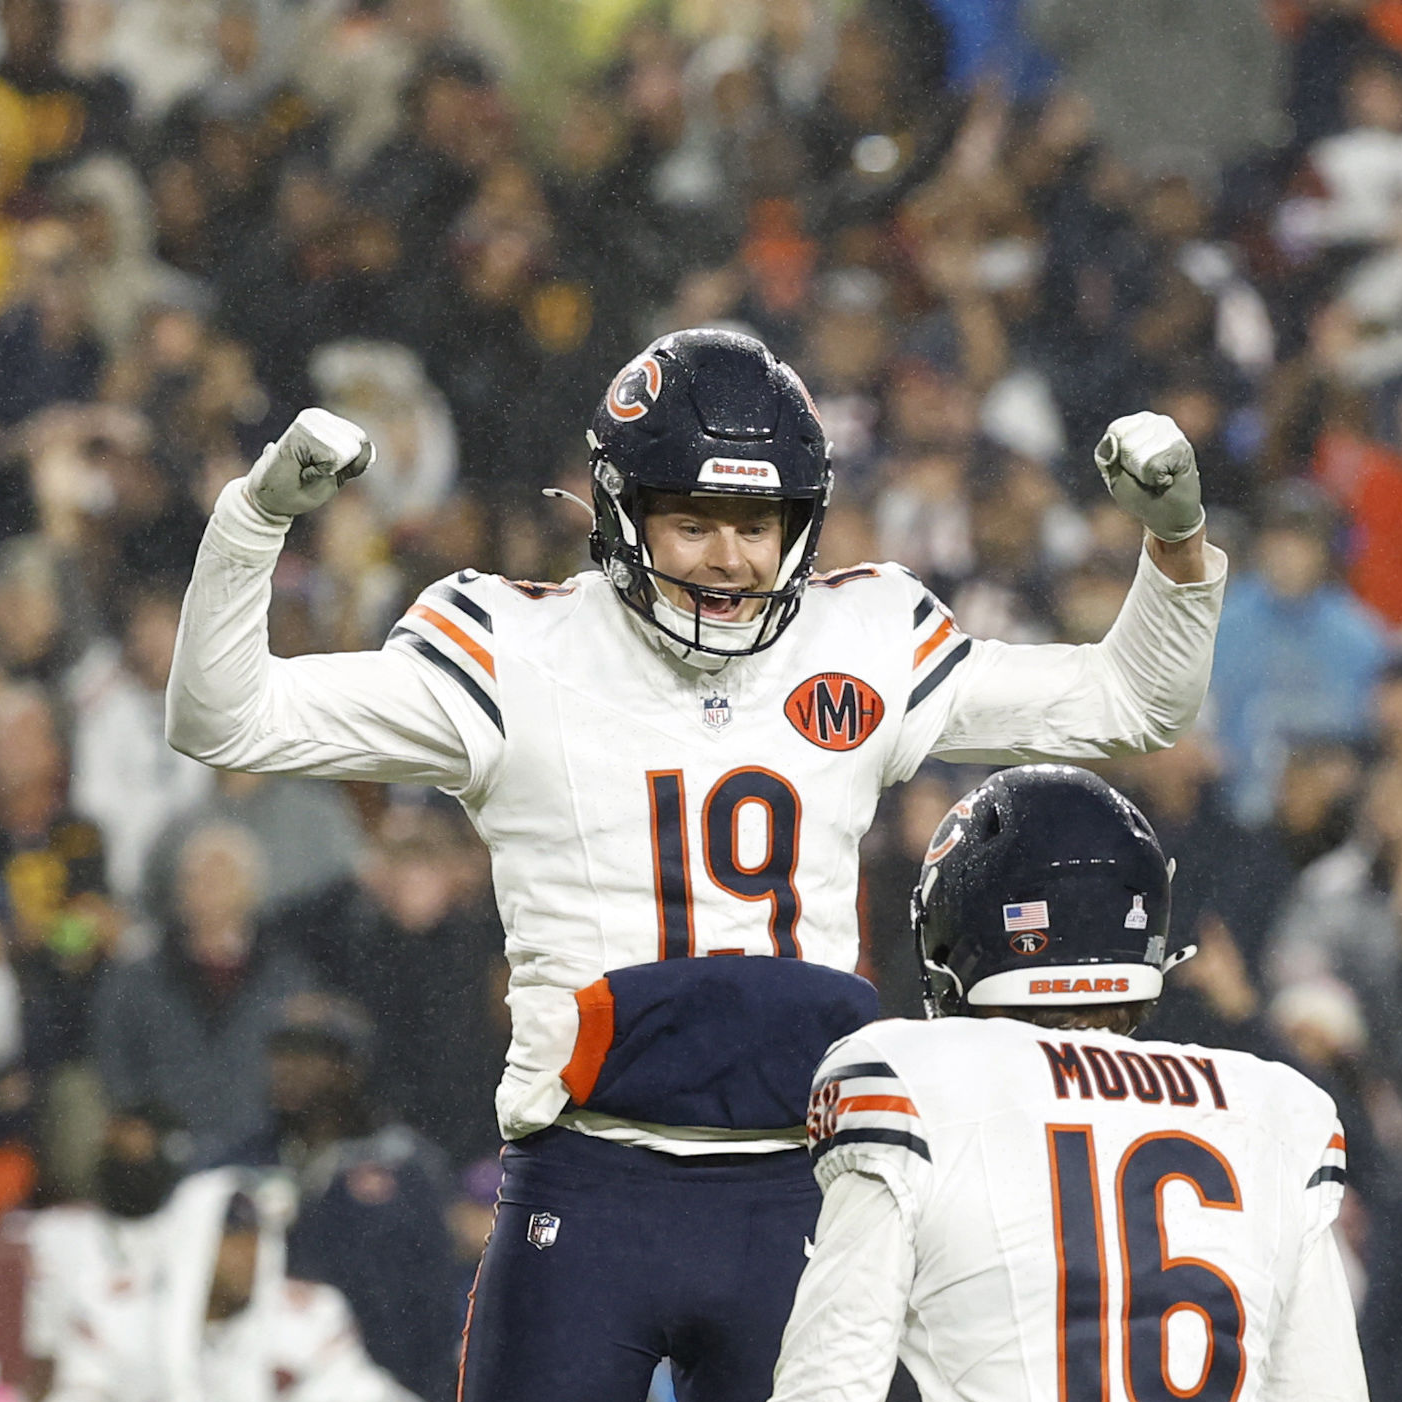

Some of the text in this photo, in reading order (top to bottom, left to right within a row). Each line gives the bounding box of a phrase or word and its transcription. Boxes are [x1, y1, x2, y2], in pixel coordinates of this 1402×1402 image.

[712, 465, 769, 477] BEARS
[645, 765, 804, 962] 19
[1021, 937, 1036, 952] 76
[1029, 978, 1129, 995] BEARS
[1037, 1040, 1228, 1110] MOODY
